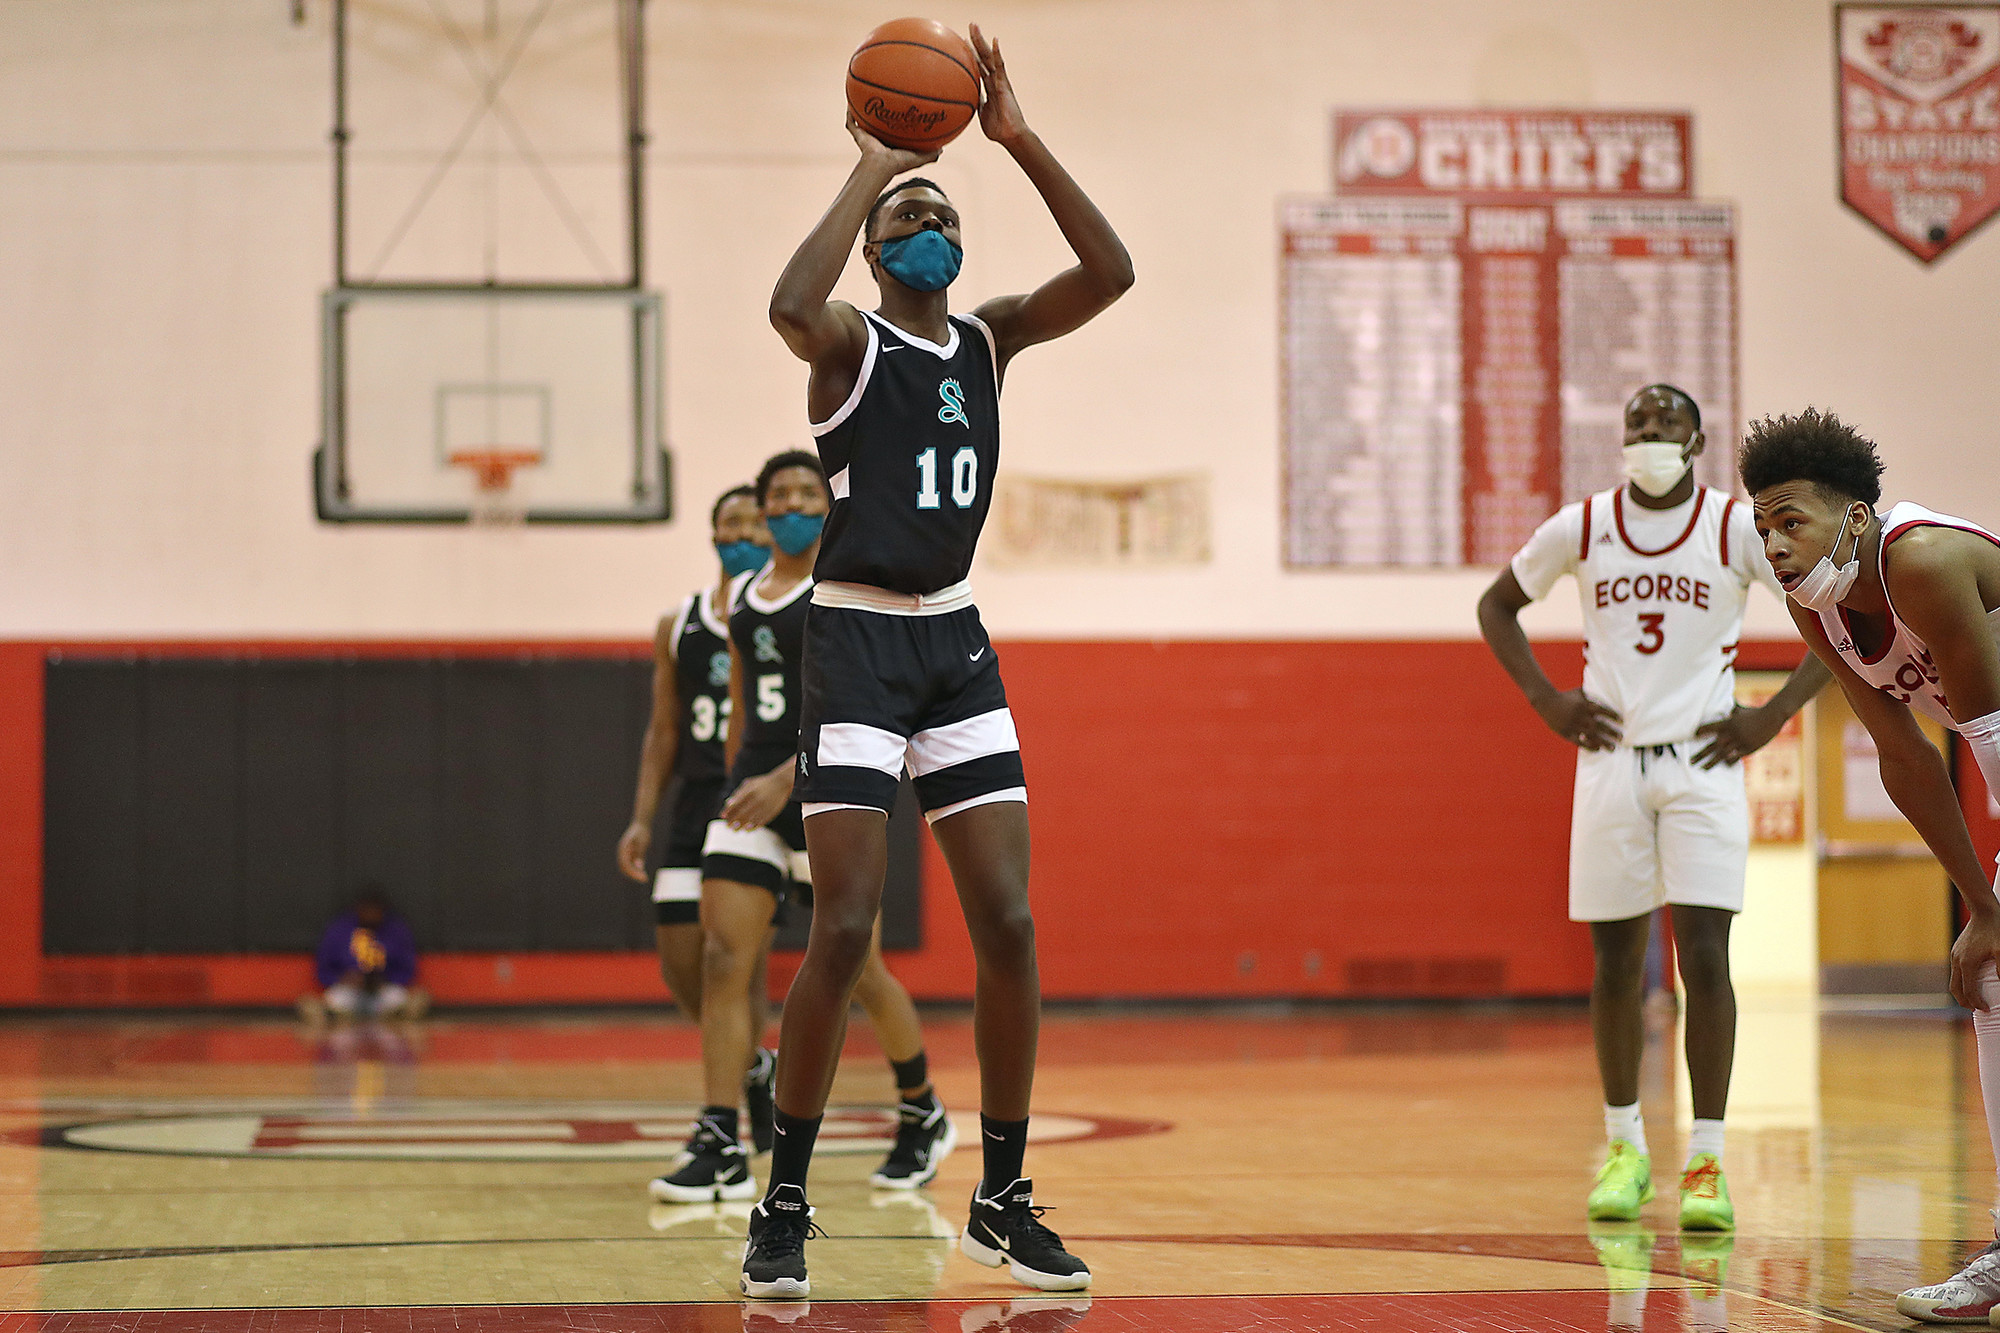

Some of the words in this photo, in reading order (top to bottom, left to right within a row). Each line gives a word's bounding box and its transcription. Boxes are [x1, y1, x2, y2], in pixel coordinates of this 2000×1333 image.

[864, 95, 947, 132] Rawlings
[1419, 137, 1684, 191] CHIEFS
[916, 446, 978, 510] 10
[1595, 574, 1710, 611] ECORSE
[1635, 613, 1665, 655] 3
[756, 672, 787, 723] 5
